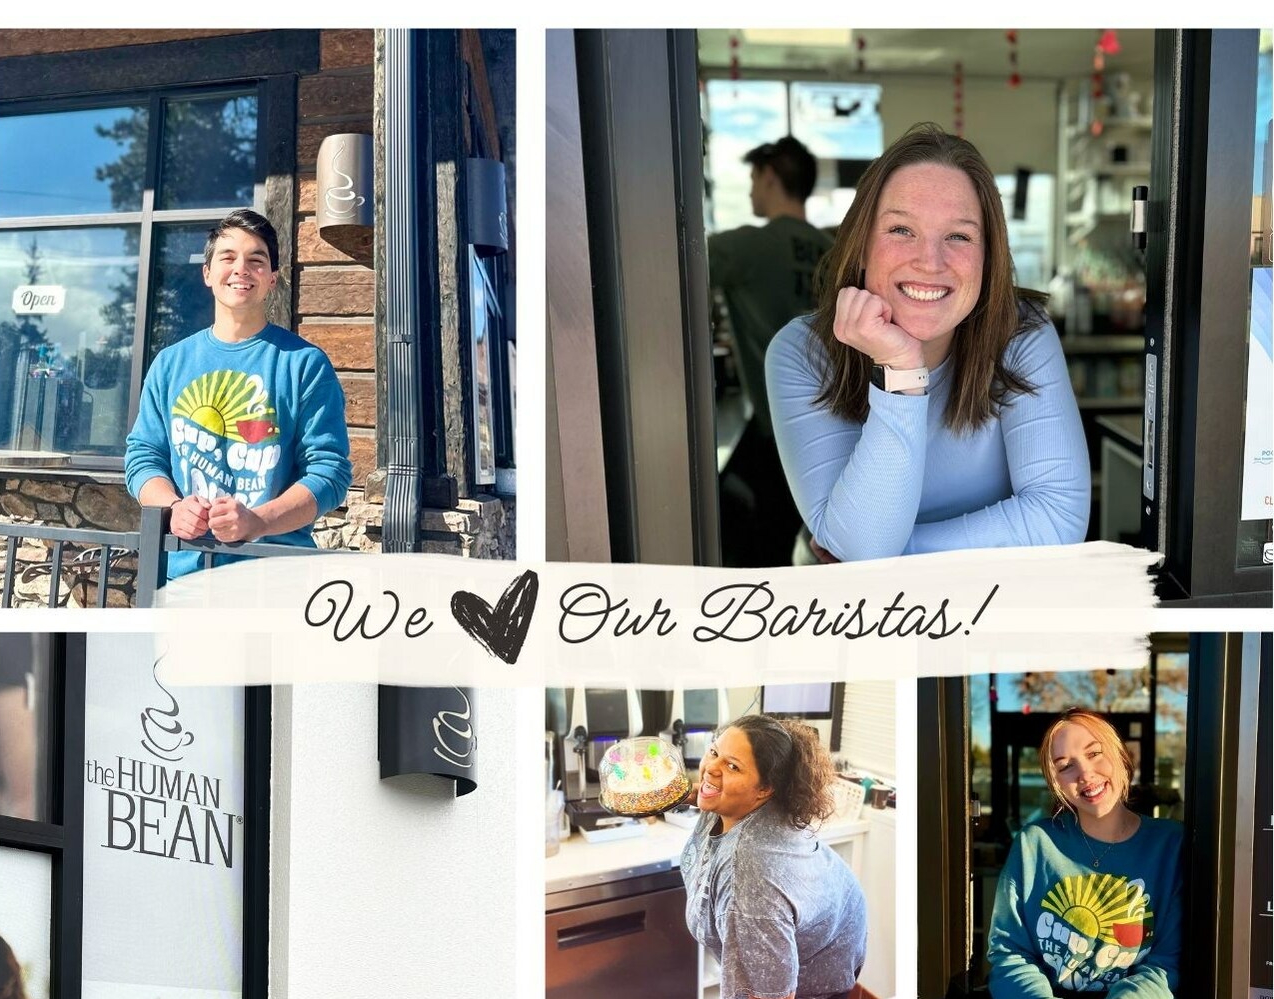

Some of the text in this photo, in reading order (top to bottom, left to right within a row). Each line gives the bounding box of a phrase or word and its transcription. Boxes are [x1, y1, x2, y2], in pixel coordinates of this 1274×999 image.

[21, 290, 57, 311] Open
[189, 450, 234, 488] HUMAN
[236, 474, 267, 491] BEAN
[227, 442, 282, 477] Cup
[85, 756, 222, 809] the HUMAN
[1038, 939, 1062, 955] THE
